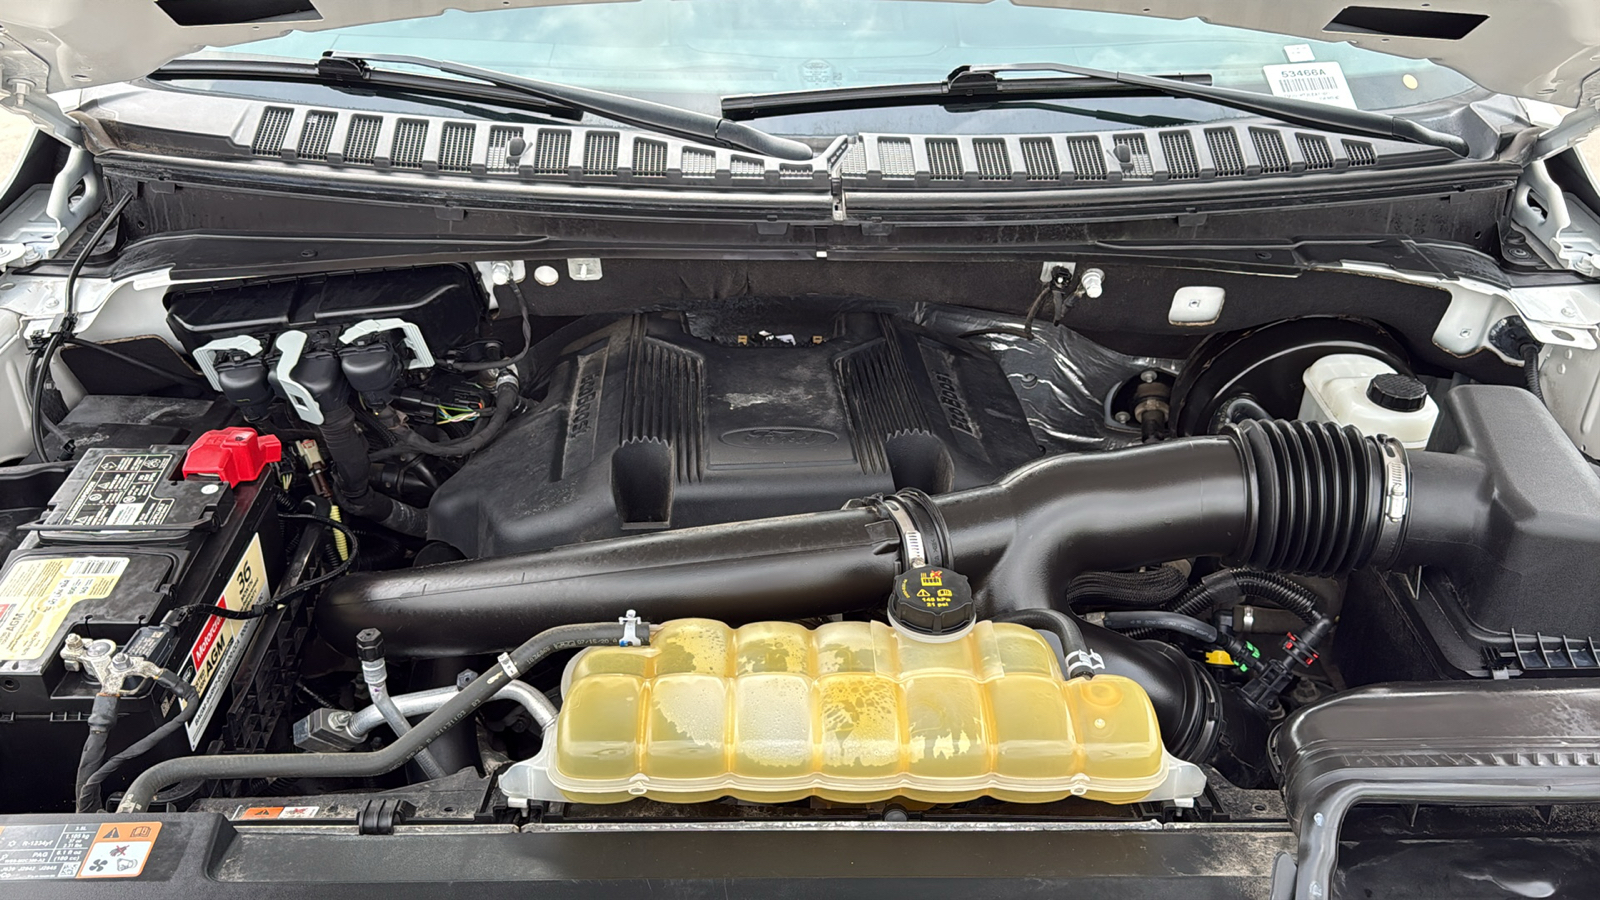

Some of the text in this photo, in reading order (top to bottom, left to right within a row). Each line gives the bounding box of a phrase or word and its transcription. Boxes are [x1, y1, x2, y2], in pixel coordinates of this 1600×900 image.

[1281, 69, 1326, 78] 53466A
[236, 560, 252, 596] 36
[195, 616, 223, 662] Motorcra
[205, 633, 226, 678] AGM
